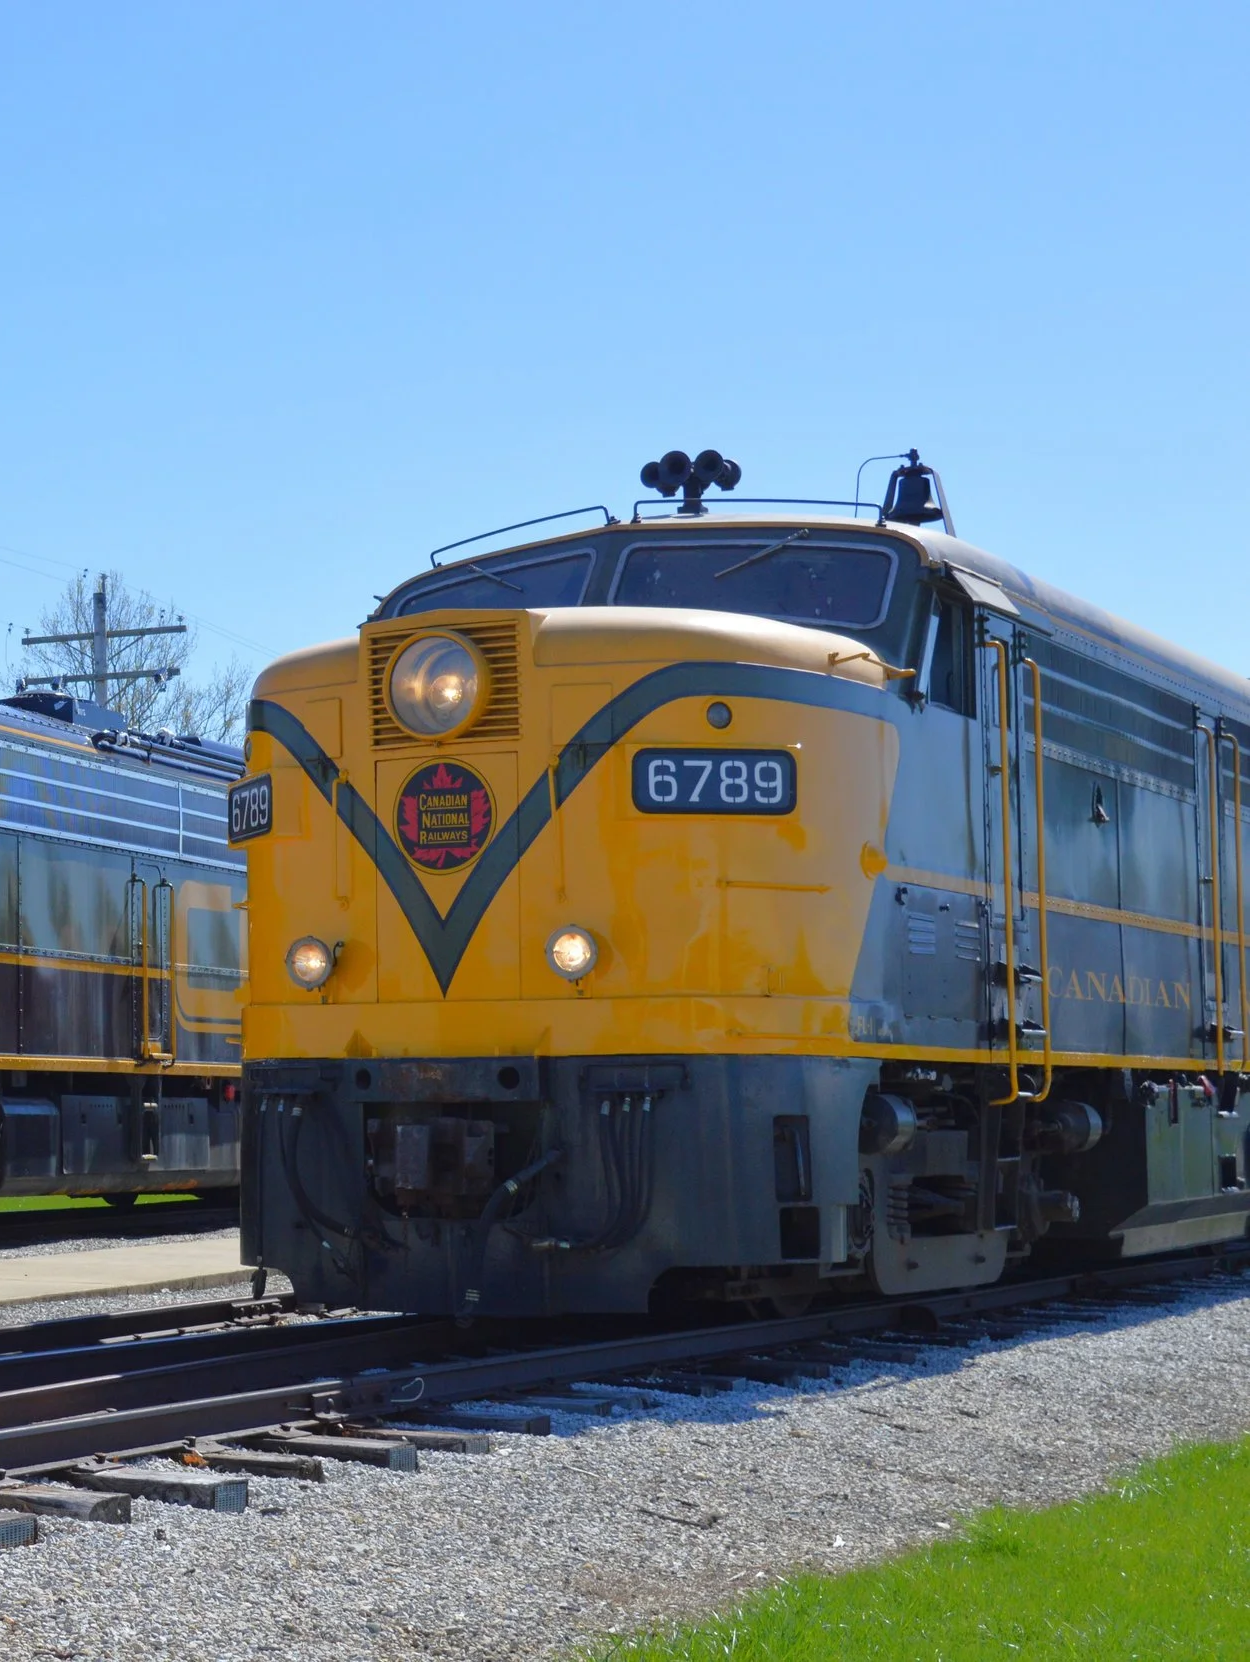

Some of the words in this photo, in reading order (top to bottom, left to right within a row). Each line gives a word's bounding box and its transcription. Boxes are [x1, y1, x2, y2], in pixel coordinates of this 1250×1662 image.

[648, 759, 783, 804] 6789
[232, 785, 269, 832] 6789
[419, 794, 468, 811] CANADIAN
[422, 812, 470, 829] NATIONAL
[419, 831, 468, 845] RAILWAYS
[1047, 966, 1191, 1010] CANADIAN
